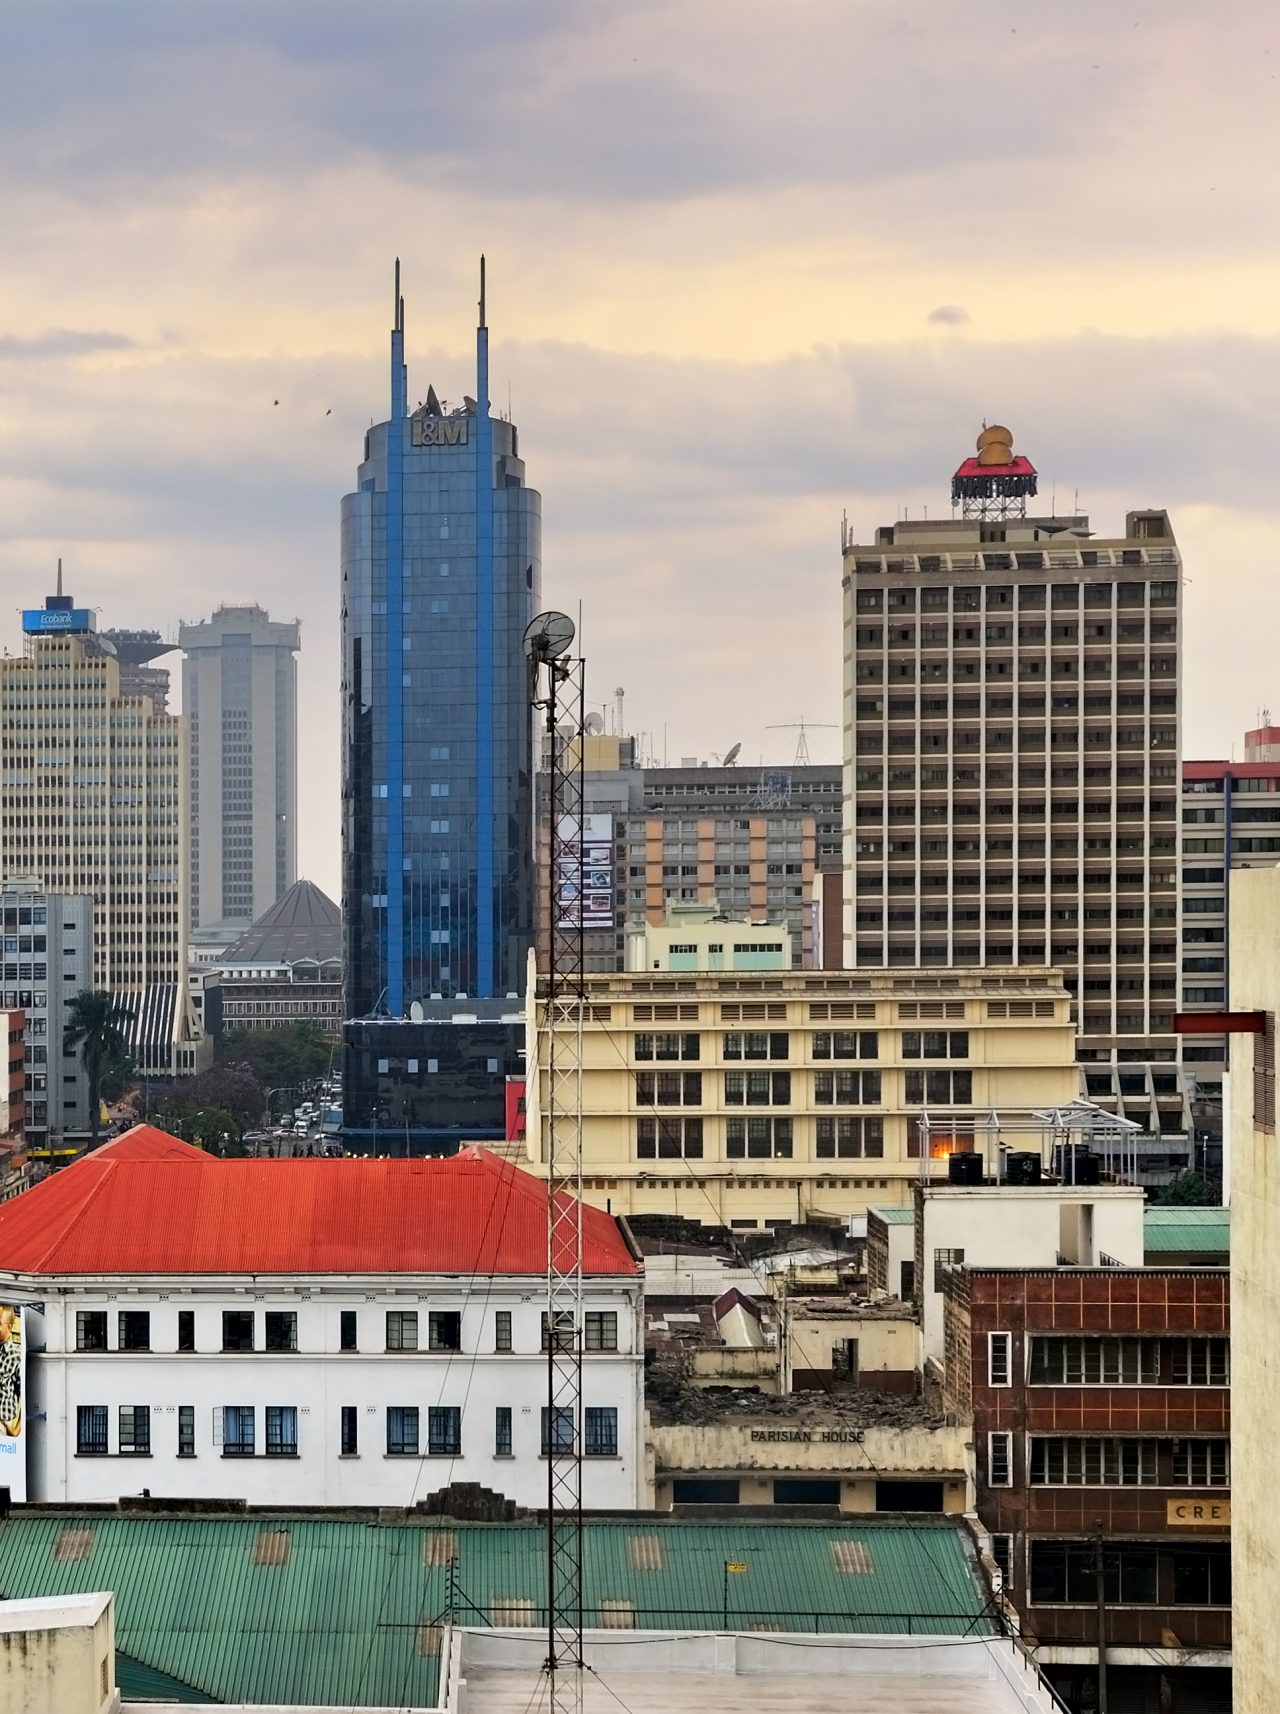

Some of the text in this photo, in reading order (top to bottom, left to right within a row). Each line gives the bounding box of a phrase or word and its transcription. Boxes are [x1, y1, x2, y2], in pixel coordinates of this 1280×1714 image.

[412, 419, 468, 447] I&M
[40, 612, 73, 624] Ecobank
[751, 1430, 865, 1442] PARISIAN HOUSE
[1176, 1505, 1231, 1519] CRE
